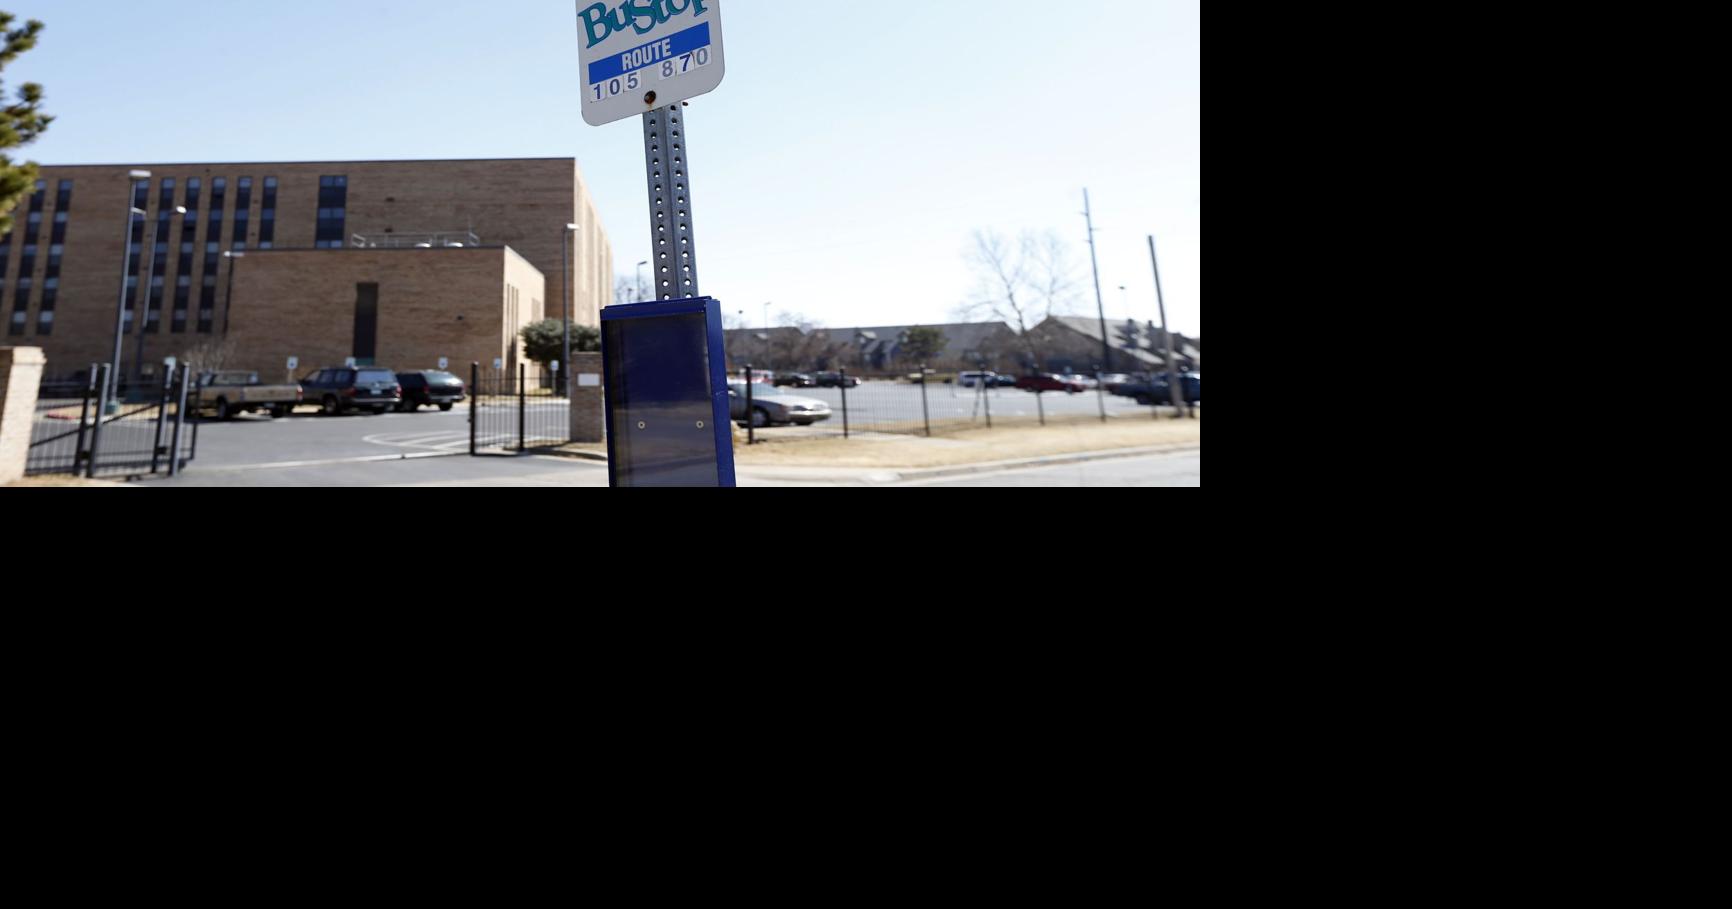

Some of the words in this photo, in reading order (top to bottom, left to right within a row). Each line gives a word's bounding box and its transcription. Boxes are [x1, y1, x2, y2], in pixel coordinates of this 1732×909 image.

[593, 72, 638, 100] 105
[661, 47, 708, 78] 870
[621, 38, 671, 71] ROUTE
